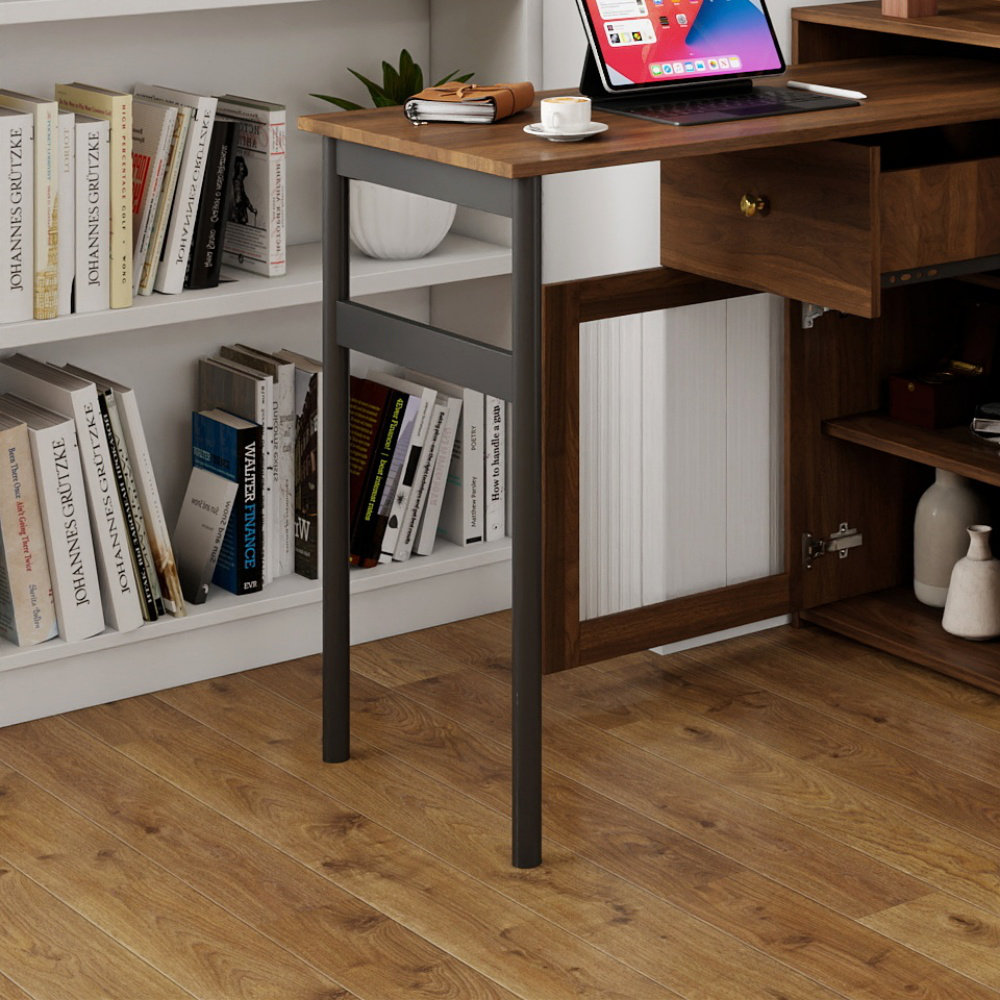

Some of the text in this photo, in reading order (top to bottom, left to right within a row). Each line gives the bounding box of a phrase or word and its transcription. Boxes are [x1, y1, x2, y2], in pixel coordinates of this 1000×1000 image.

[8, 127, 23, 290] JOHANNES GRÜTZKE
[86, 130, 100, 286] JOHANNES GRÜTZKE
[491, 432, 499, 464] handle
[491, 466, 499, 476] to
[492, 404, 501, 423] gun
[7, 446, 33, 572] Been There Once Ain't Going There Twice
[50, 437, 90, 606] JOHANNES GRÜTZKE
[81, 401, 132, 594] JOHANNES GRÜTZKE
[244, 441, 255, 568] WALTER FINANCE
[491, 478, 499, 500] How
